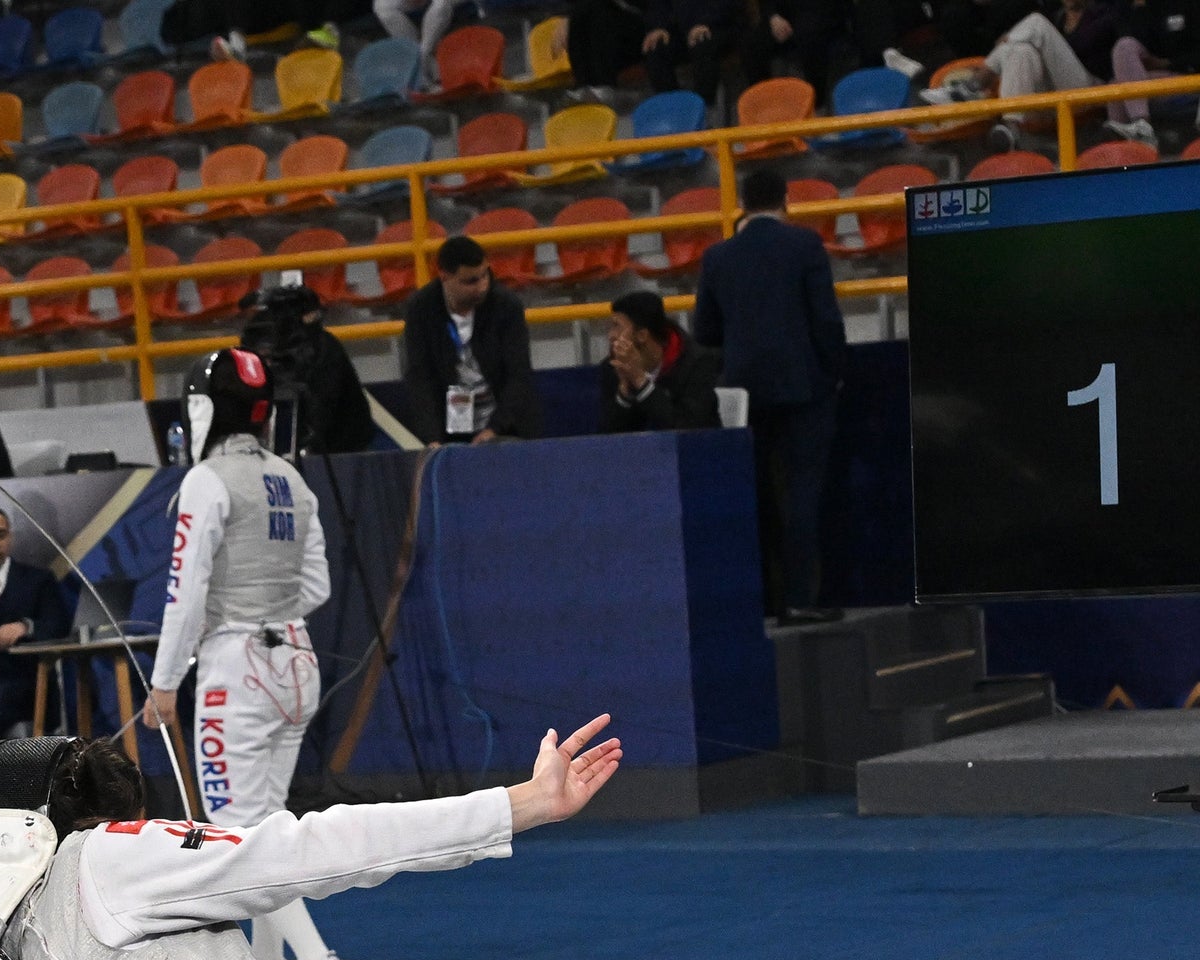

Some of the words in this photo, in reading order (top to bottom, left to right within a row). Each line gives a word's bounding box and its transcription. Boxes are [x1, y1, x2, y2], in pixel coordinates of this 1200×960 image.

[1067, 362, 1119, 505] 1
[263, 474, 294, 507] SIM
[269, 511, 295, 541] KOR
[200, 717, 233, 813] KOREA
